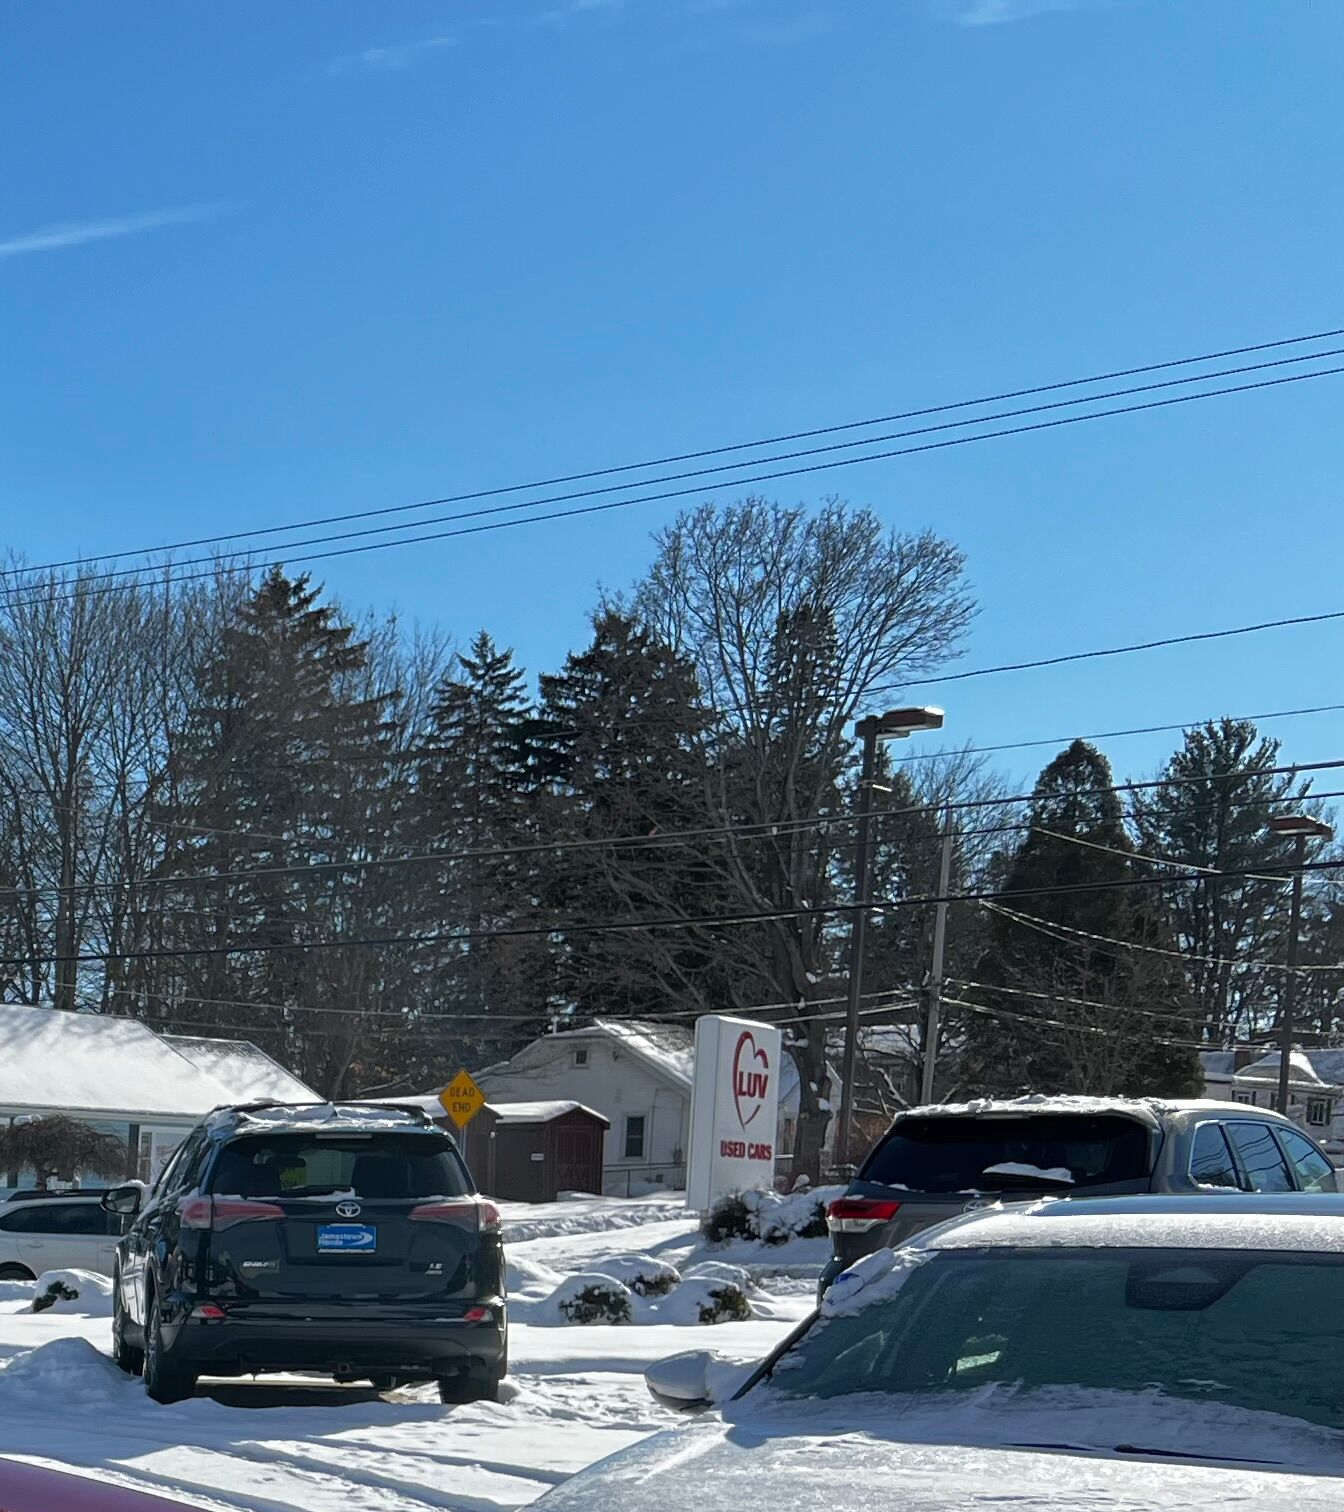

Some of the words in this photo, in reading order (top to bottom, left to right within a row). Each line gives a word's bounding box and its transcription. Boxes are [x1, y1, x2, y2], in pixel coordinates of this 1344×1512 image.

[449, 1086, 475, 1097] DEAD
[736, 1070, 769, 1099] LUV
[452, 1102, 471, 1113] END
[720, 1140, 746, 1158] USED
[747, 1142, 772, 1161] CARS
